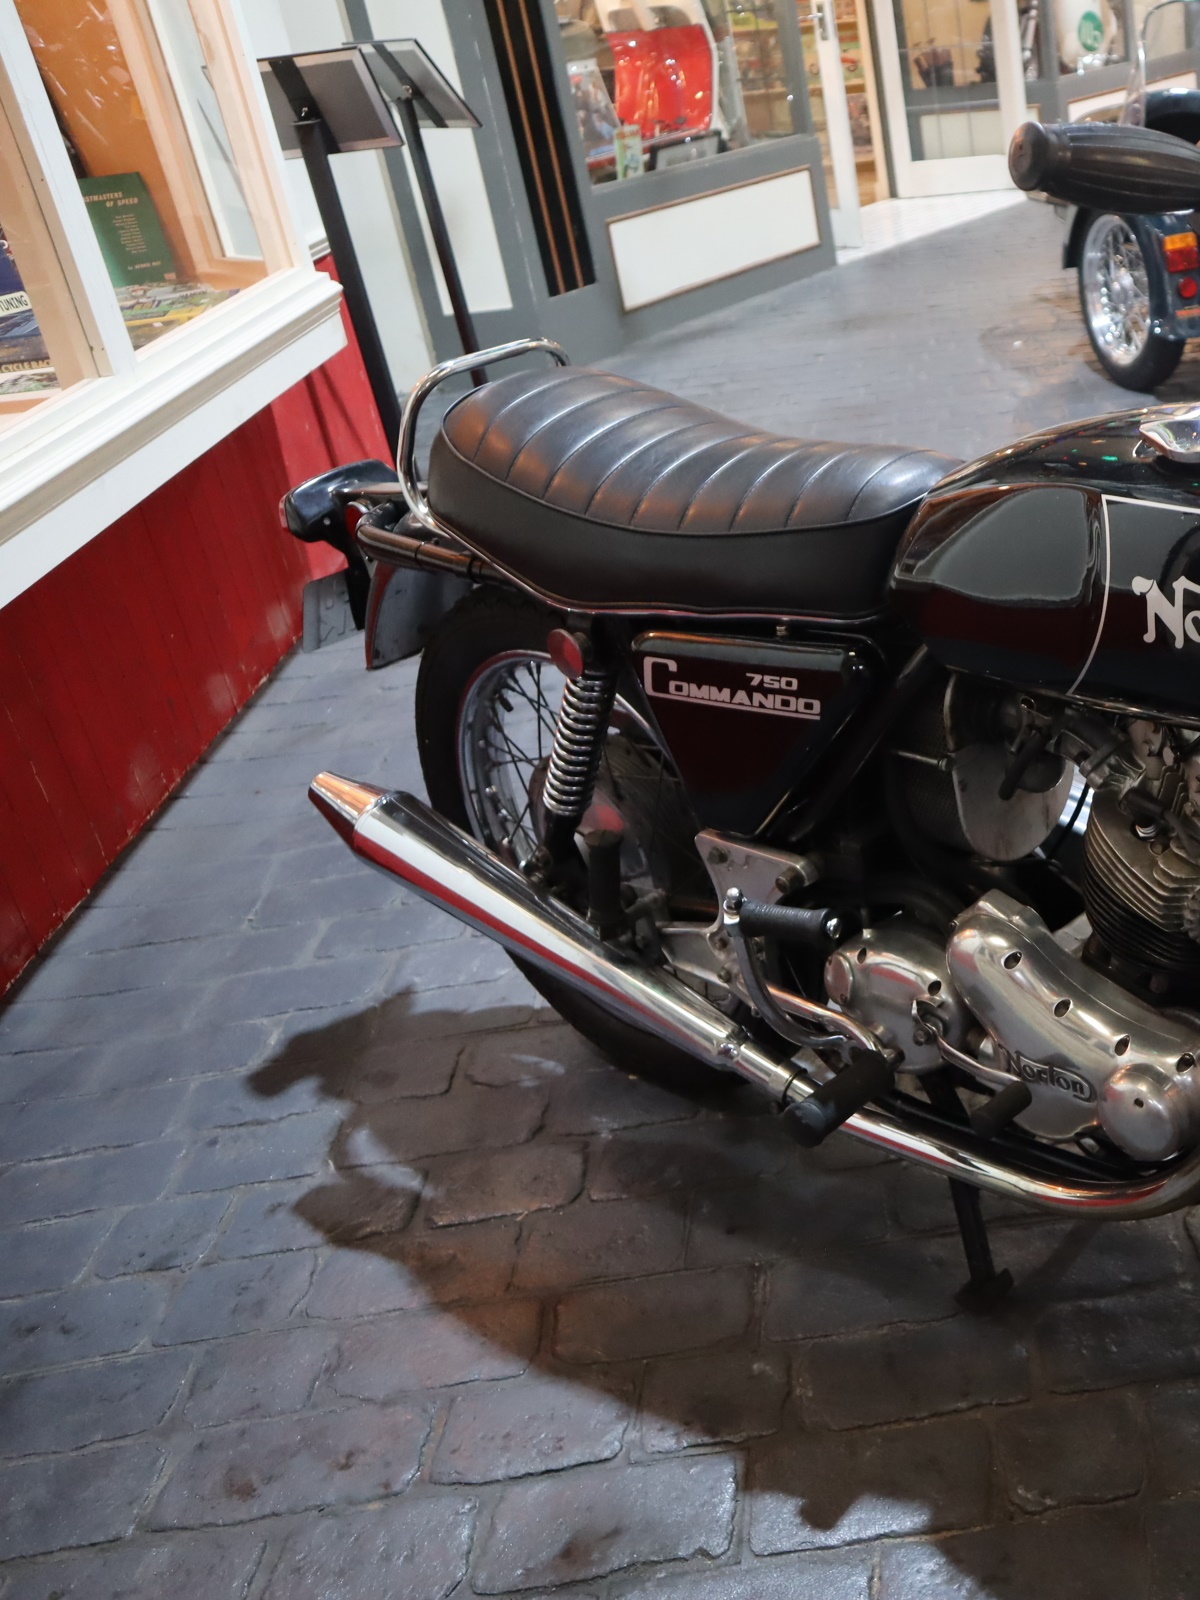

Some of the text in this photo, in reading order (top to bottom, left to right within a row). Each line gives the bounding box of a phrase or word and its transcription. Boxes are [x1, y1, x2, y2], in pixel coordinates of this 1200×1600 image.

[118, 197, 138, 206] SPEED
[746, 672, 798, 691] 750
[998, 1043, 1097, 1103] Norton
